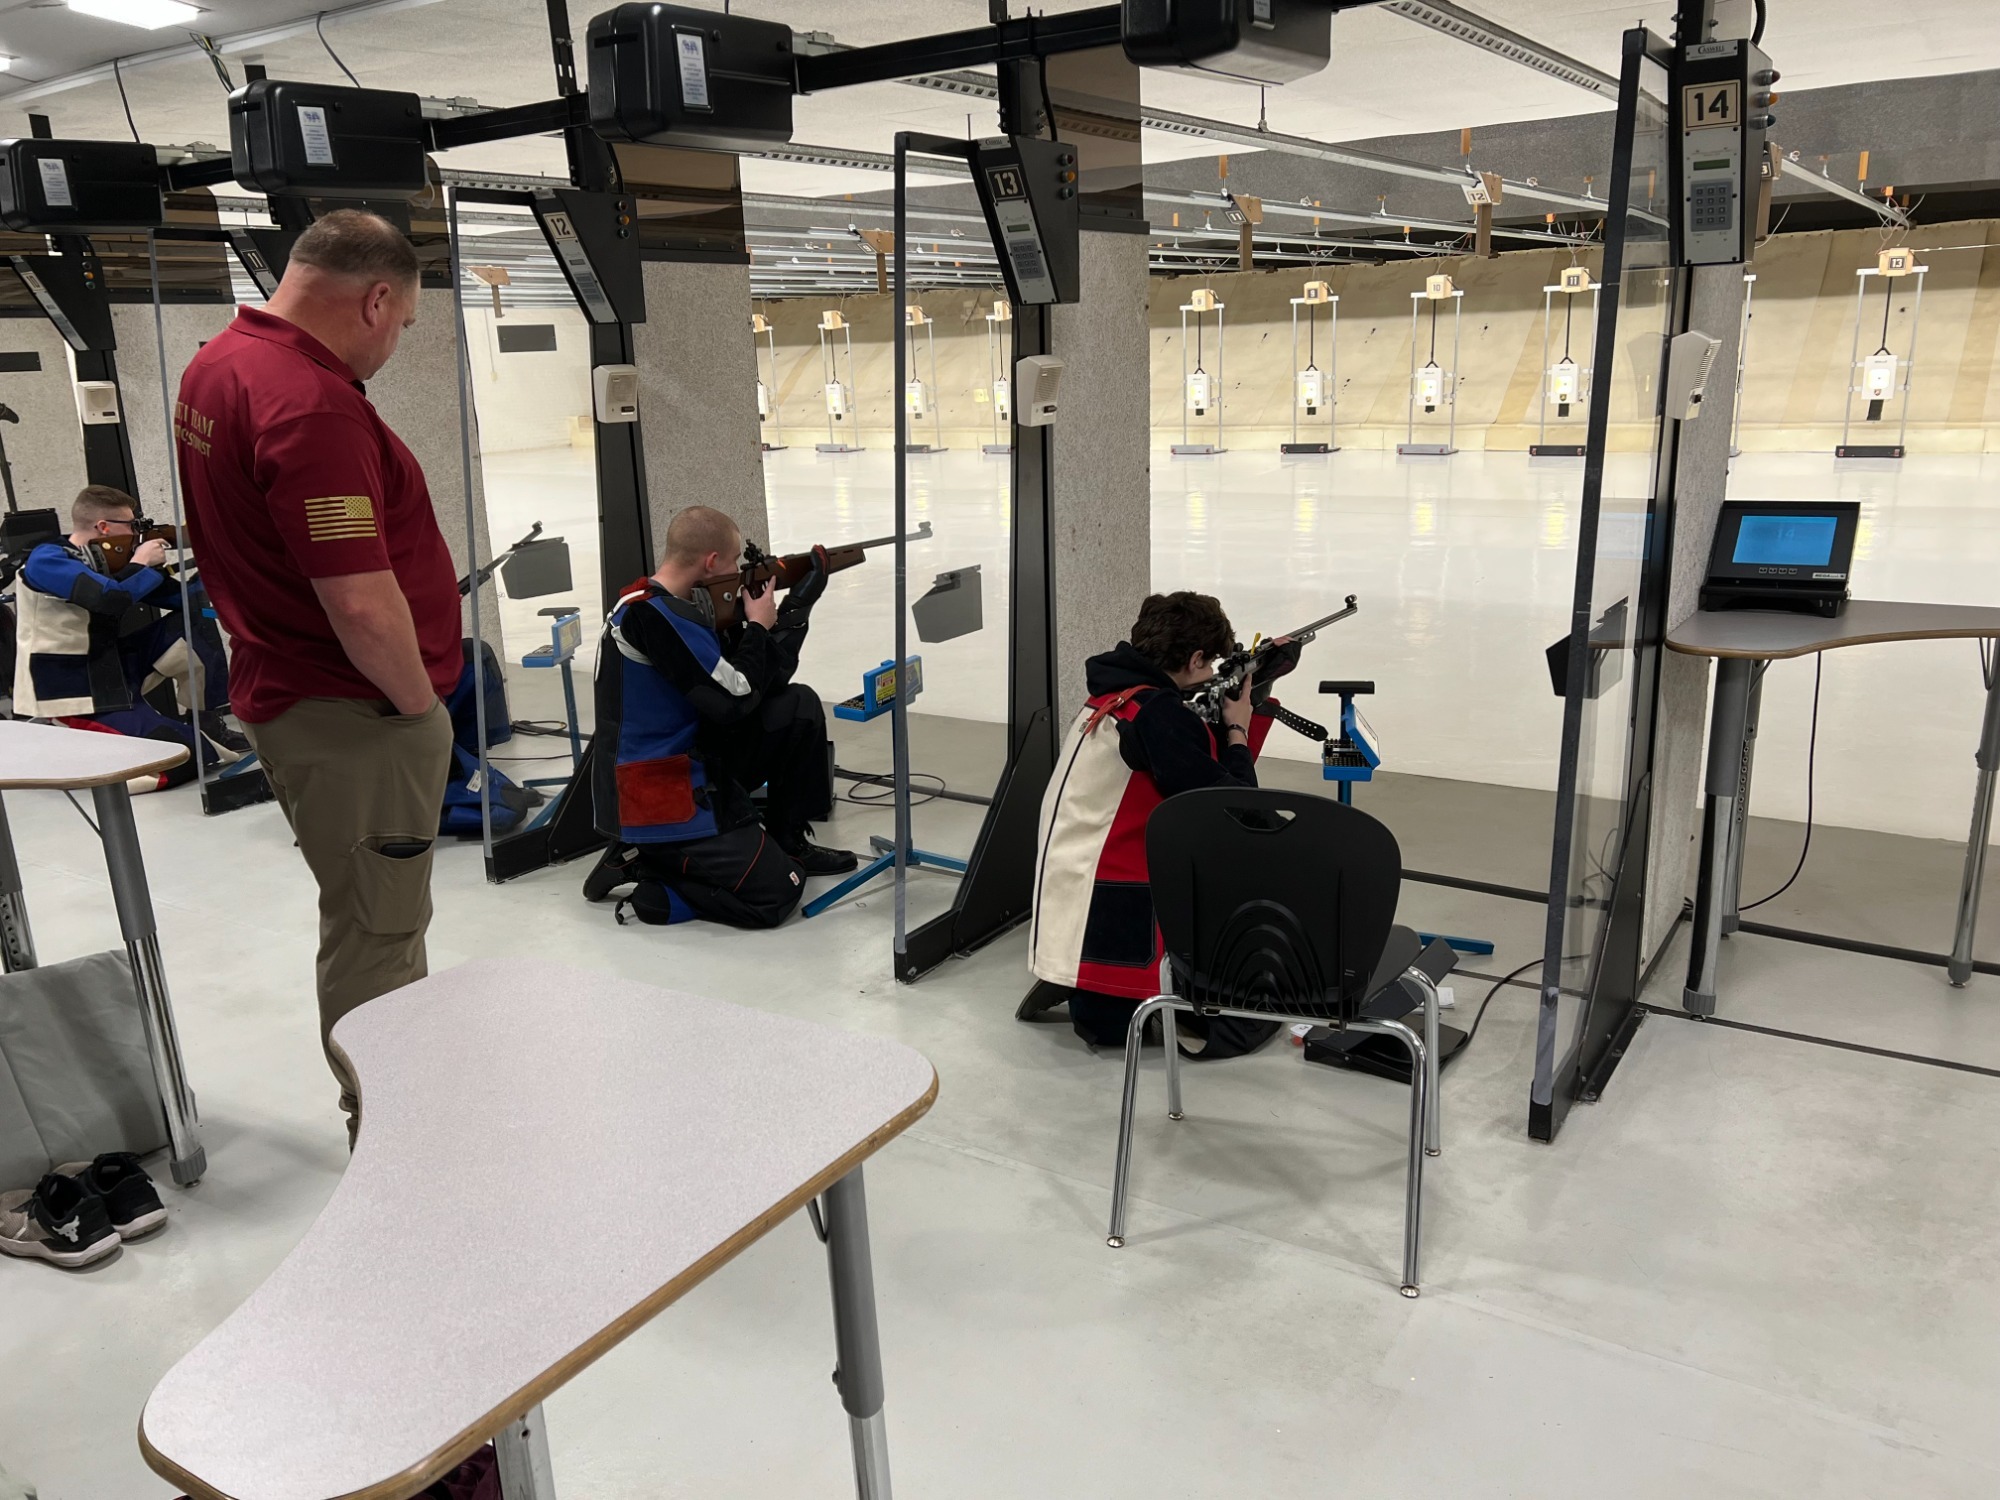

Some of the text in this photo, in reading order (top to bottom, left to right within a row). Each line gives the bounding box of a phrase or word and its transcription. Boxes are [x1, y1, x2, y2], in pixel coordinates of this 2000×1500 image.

[1694, 90, 1729, 121] 14
[994, 172, 1018, 196] 13
[1470, 192, 1486, 201] 12
[1230, 213, 1242, 221] 11
[551, 217, 571, 236] 12
[247, 252, 264, 268] 11
[1892, 258, 1903, 268] 13
[1569, 276, 1578, 285] 11
[1433, 284, 1441, 292] 10
